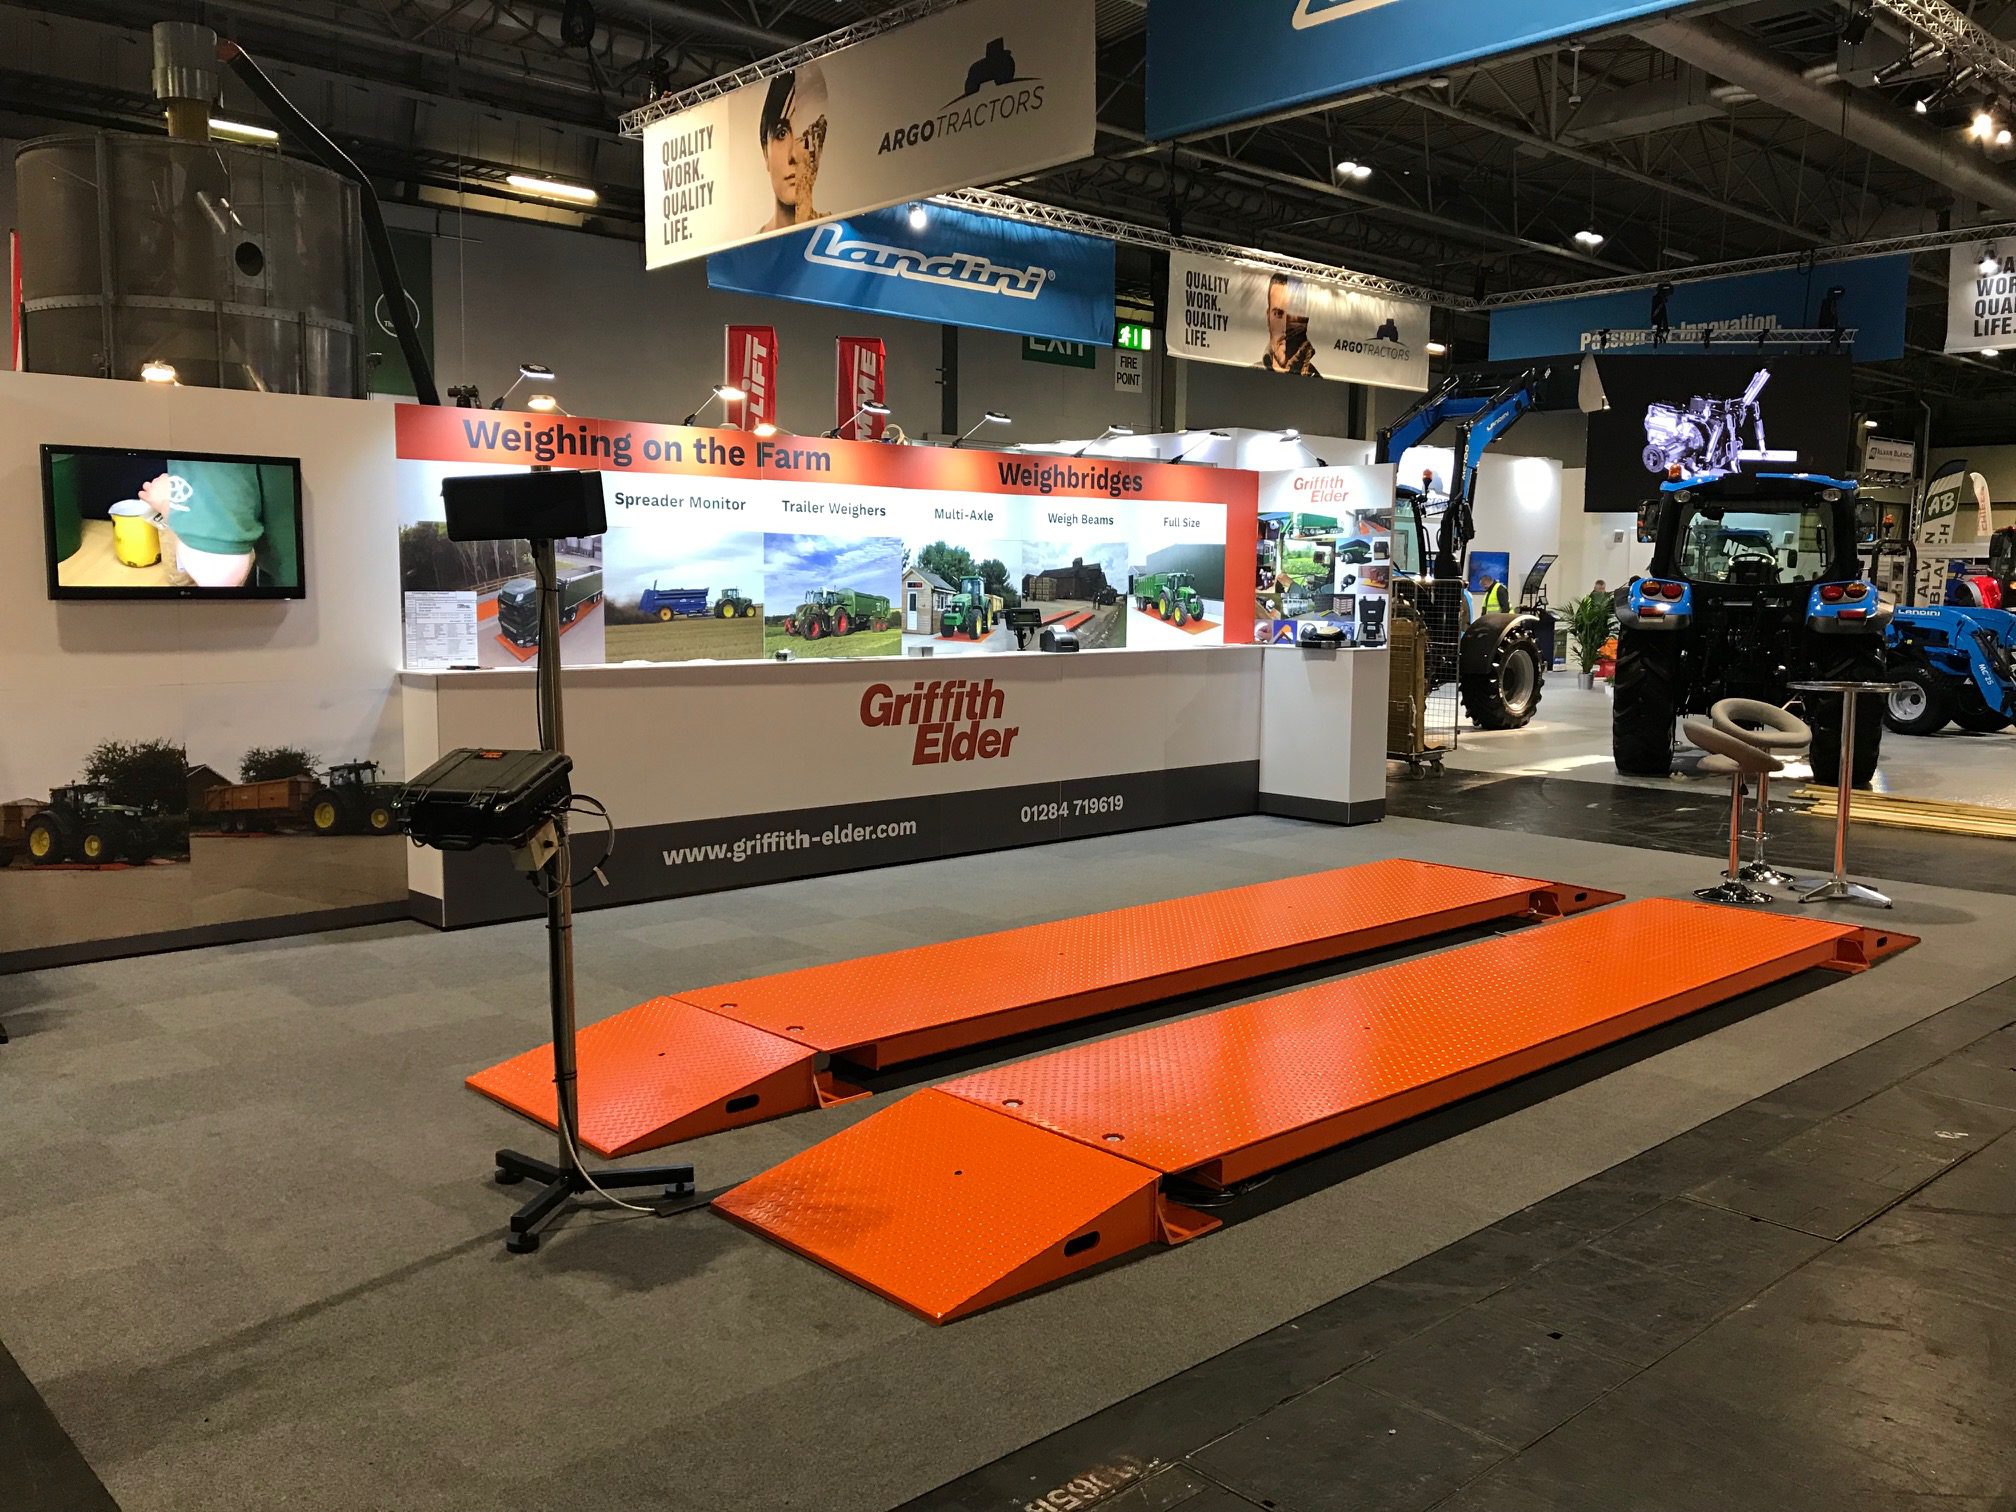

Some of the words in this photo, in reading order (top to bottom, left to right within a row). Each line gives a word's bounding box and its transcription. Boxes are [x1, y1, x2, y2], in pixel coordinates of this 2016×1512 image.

[878, 85, 1045, 155] ARGOTRACTORS
[662, 124, 714, 166] QUALITY
[662, 157, 705, 191] WORK.
[663, 181, 714, 219] QUALITY
[663, 217, 693, 245] LIFE.
[1185, 270, 1230, 295] QUALITY
[1185, 290, 1222, 312] WORK.
[1974, 297, 2016, 318] QUA
[1185, 309, 1229, 332] QUALITY
[1185, 327, 1210, 348] LIFE.
[1333, 338, 1410, 361] ARGOTRACTORS
[1120, 356, 1138, 369] FIRE
[1117, 372, 1141, 386] POINT
[462, 419, 633, 467] Weighing
[643, 438, 683, 462] on
[693, 436, 746, 467] the
[756, 441, 831, 471] Farm
[998, 461, 1143, 497] Weighbridges
[1294, 475, 1344, 491] Griffith
[614, 492, 685, 508] Spreader
[690, 496, 746, 511] Monitor
[1311, 489, 1349, 503] Elder
[1928, 492, 1955, 516] AB
[782, 500, 825, 514] Trailer
[829, 502, 886, 518] Weighers
[934, 508, 994, 522] Multi-Axle
[1047, 513, 1078, 526] Weigh
[1081, 513, 1114, 526] Beams
[1163, 517, 1180, 528] Full
[1182, 517, 1201, 528] Size
[1917, 531, 1936, 599] ALVN
[1898, 608, 1941, 617] LANDINI
[860, 679, 1005, 727] Griffith
[912, 720, 1020, 765] Elder
[1020, 802, 1069, 823] 01284
[1073, 794, 1124, 817] 719619
[662, 818, 918, 866] www.griffith-elder.com
